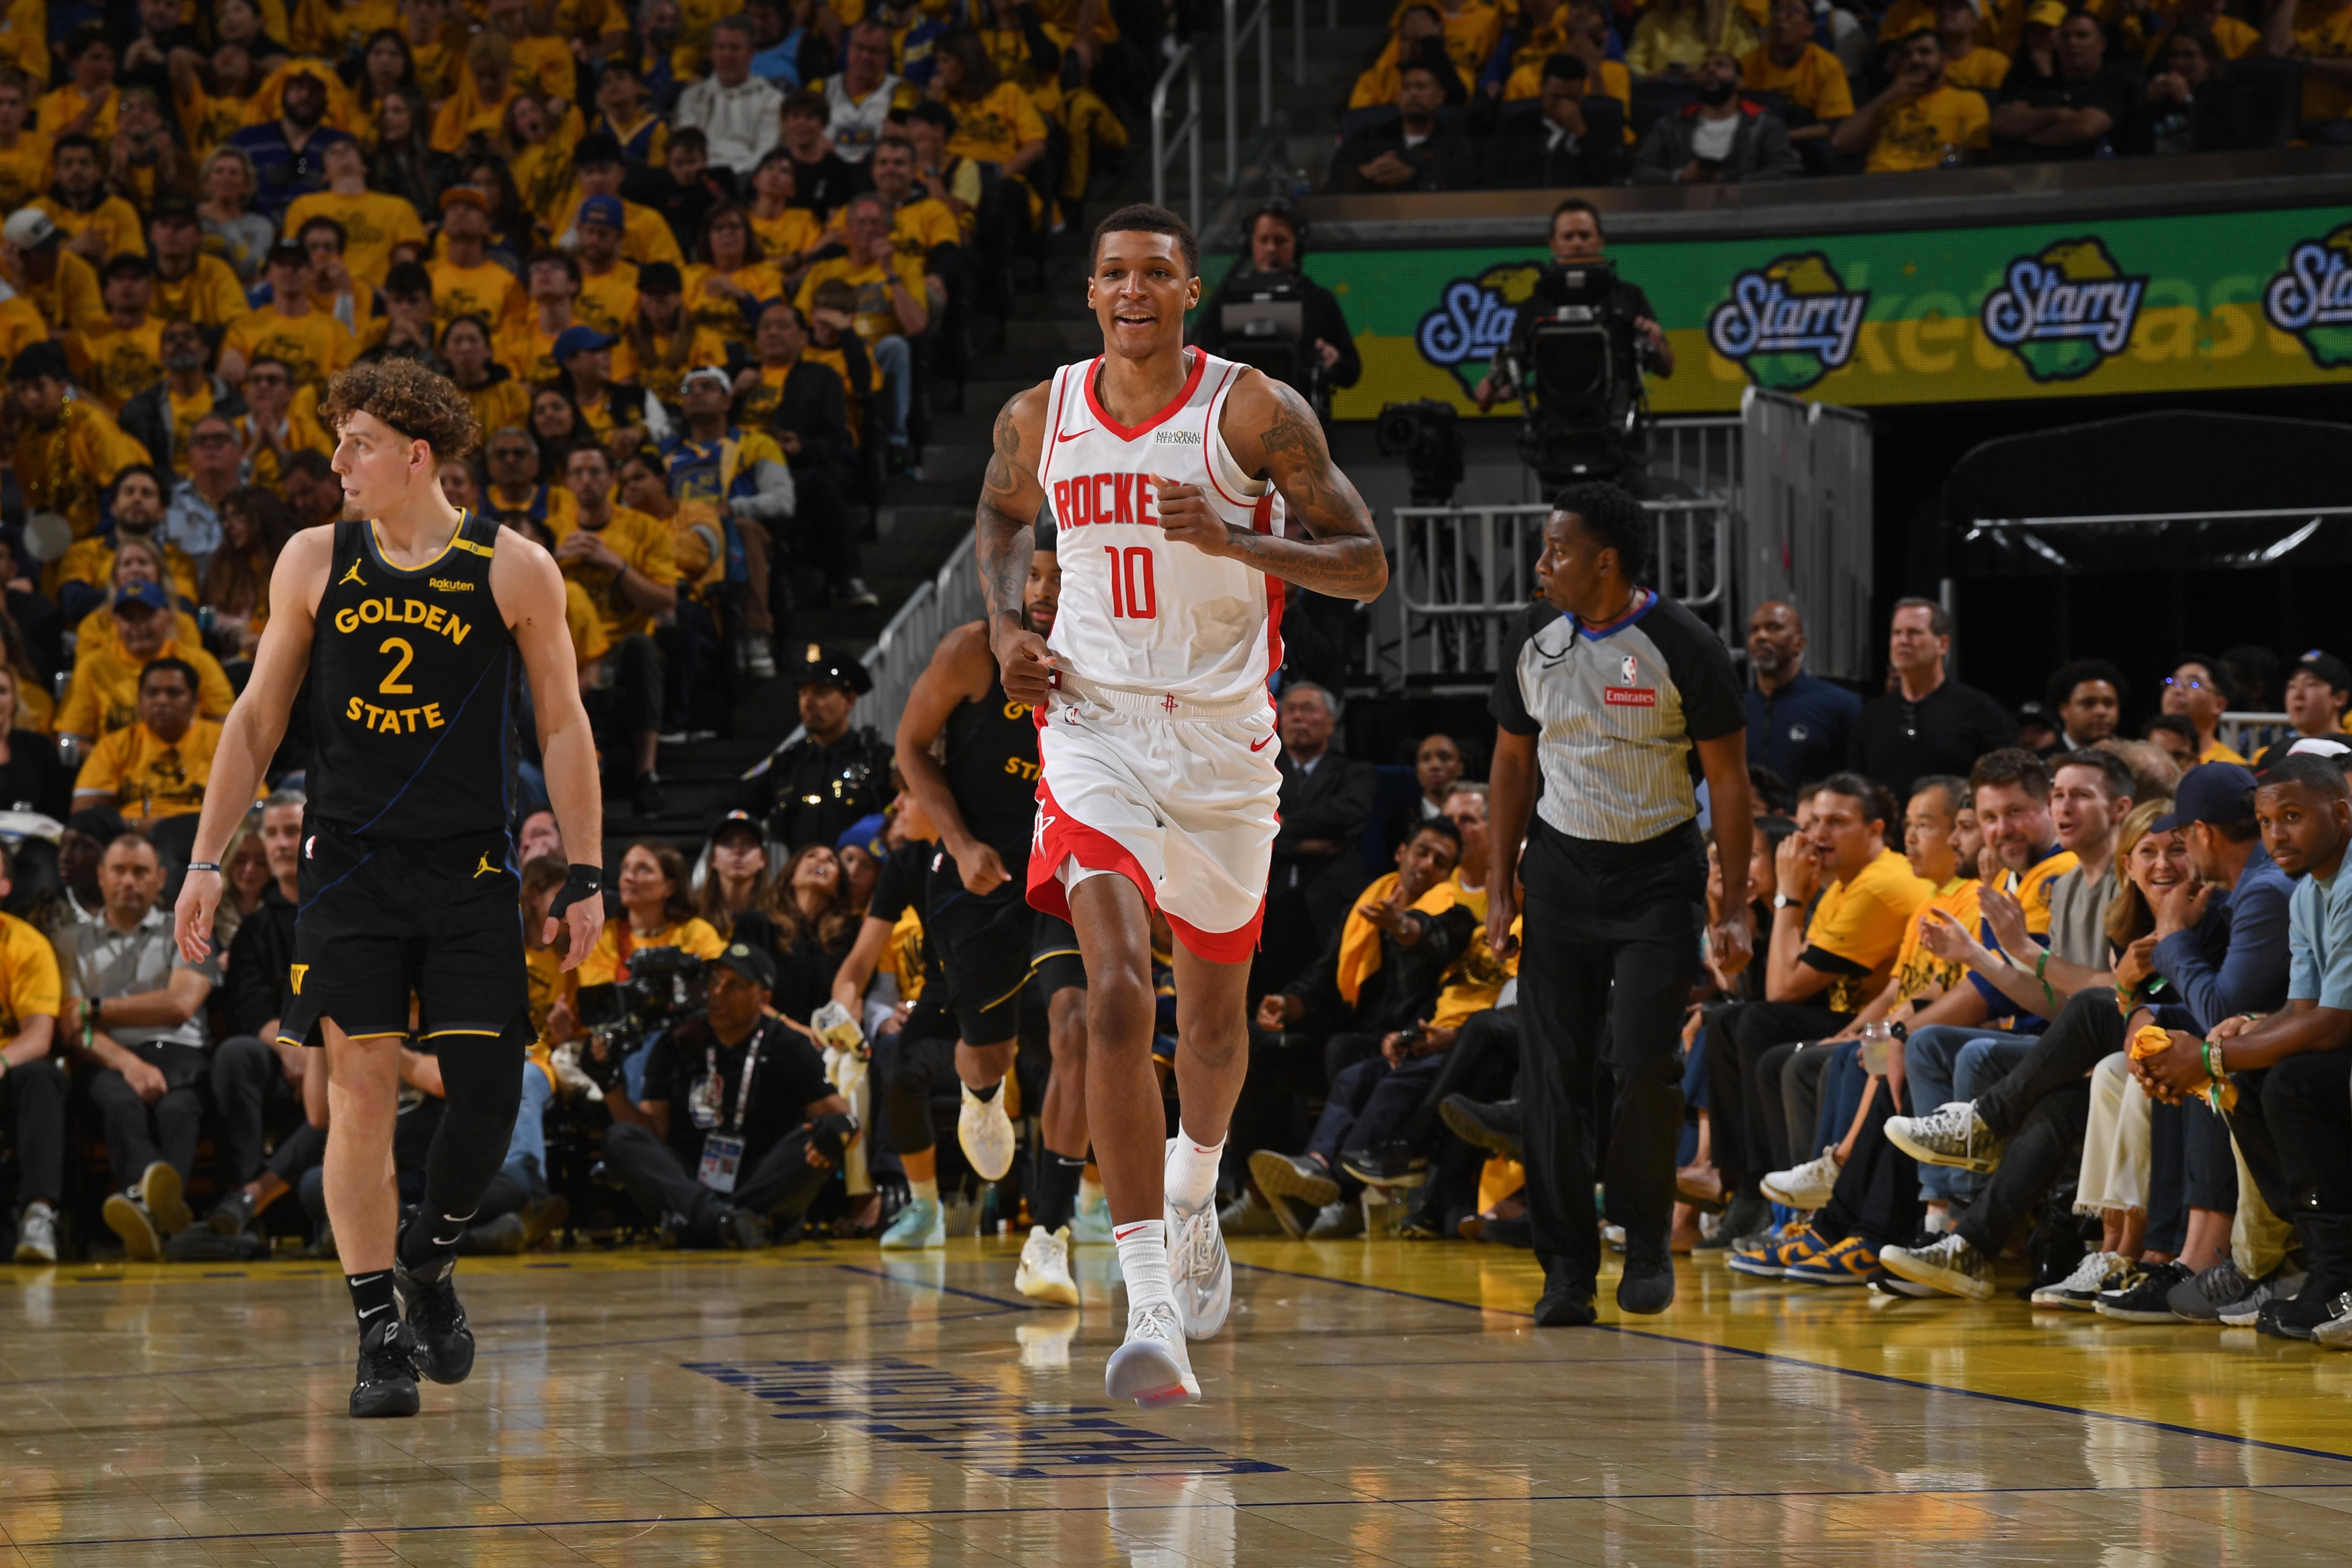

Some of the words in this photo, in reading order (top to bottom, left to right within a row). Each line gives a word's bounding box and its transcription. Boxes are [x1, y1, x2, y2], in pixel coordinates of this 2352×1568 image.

[1986, 261, 2142, 352] Starry
[2269, 245, 2352, 329] Sta
[1420, 283, 1518, 363] Sta
[1713, 275, 1863, 366] Starry
[1157, 431, 1201, 439] MEMORIAL
[1054, 472, 1181, 532] ROCKE
[430, 578, 474, 591] Rakuten
[1104, 546, 1157, 619] 10
[1269, 551, 1287, 563] love
[335, 597, 471, 645] GOLDEN
[379, 637, 413, 694] 2
[346, 696, 445, 734] STATE
[1606, 690, 1654, 703] Emirates
